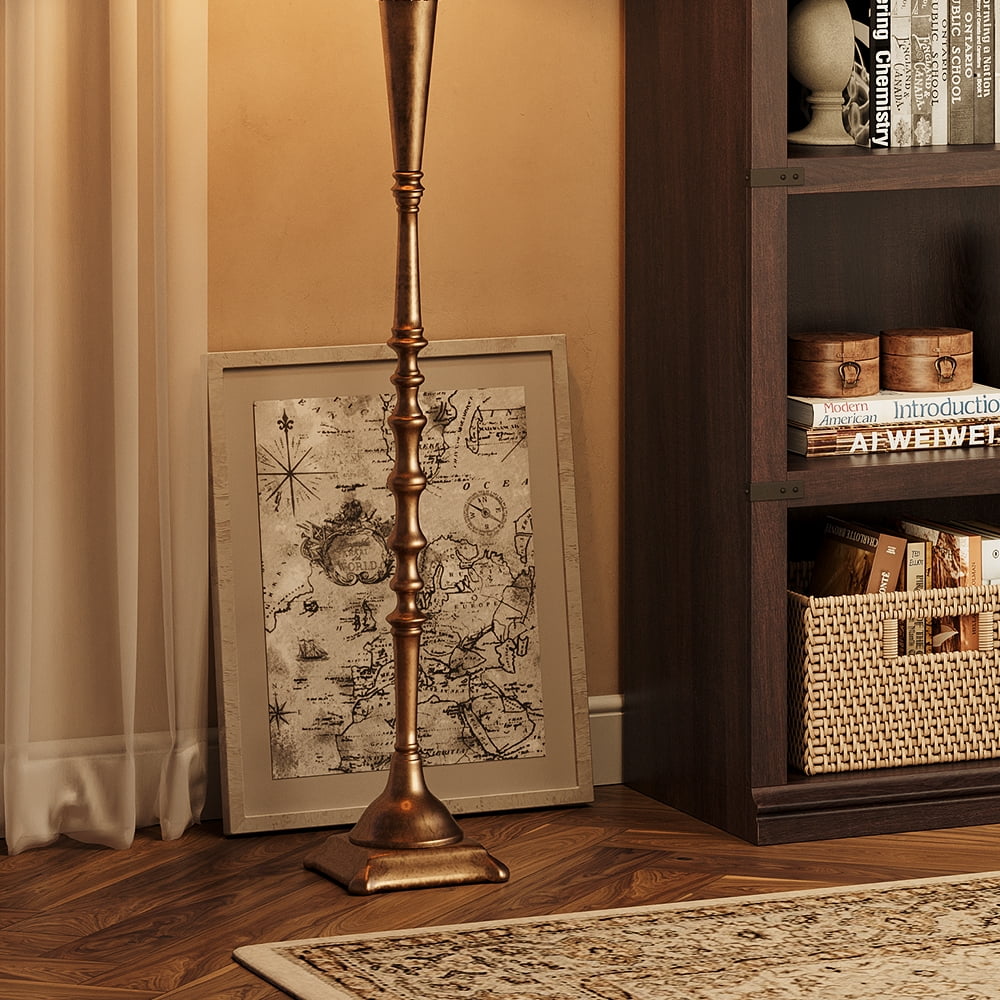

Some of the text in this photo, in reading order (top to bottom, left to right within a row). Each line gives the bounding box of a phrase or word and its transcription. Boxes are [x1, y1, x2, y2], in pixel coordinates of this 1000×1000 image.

[964, 12, 973, 78] ONTARIO
[931, 52, 939, 106] SCHOOL
[951, 46, 962, 104] SCHOOL
[983, 56, 992, 97] Nation
[873, 50, 891, 146] Chemistry
[819, 413, 877, 426] American
[823, 402, 869, 414] Modern
[850, 423, 995, 453] AI WEIWEI
[846, 530, 879, 548] CHARLOTTE
[879, 571, 891, 593] ONTE
